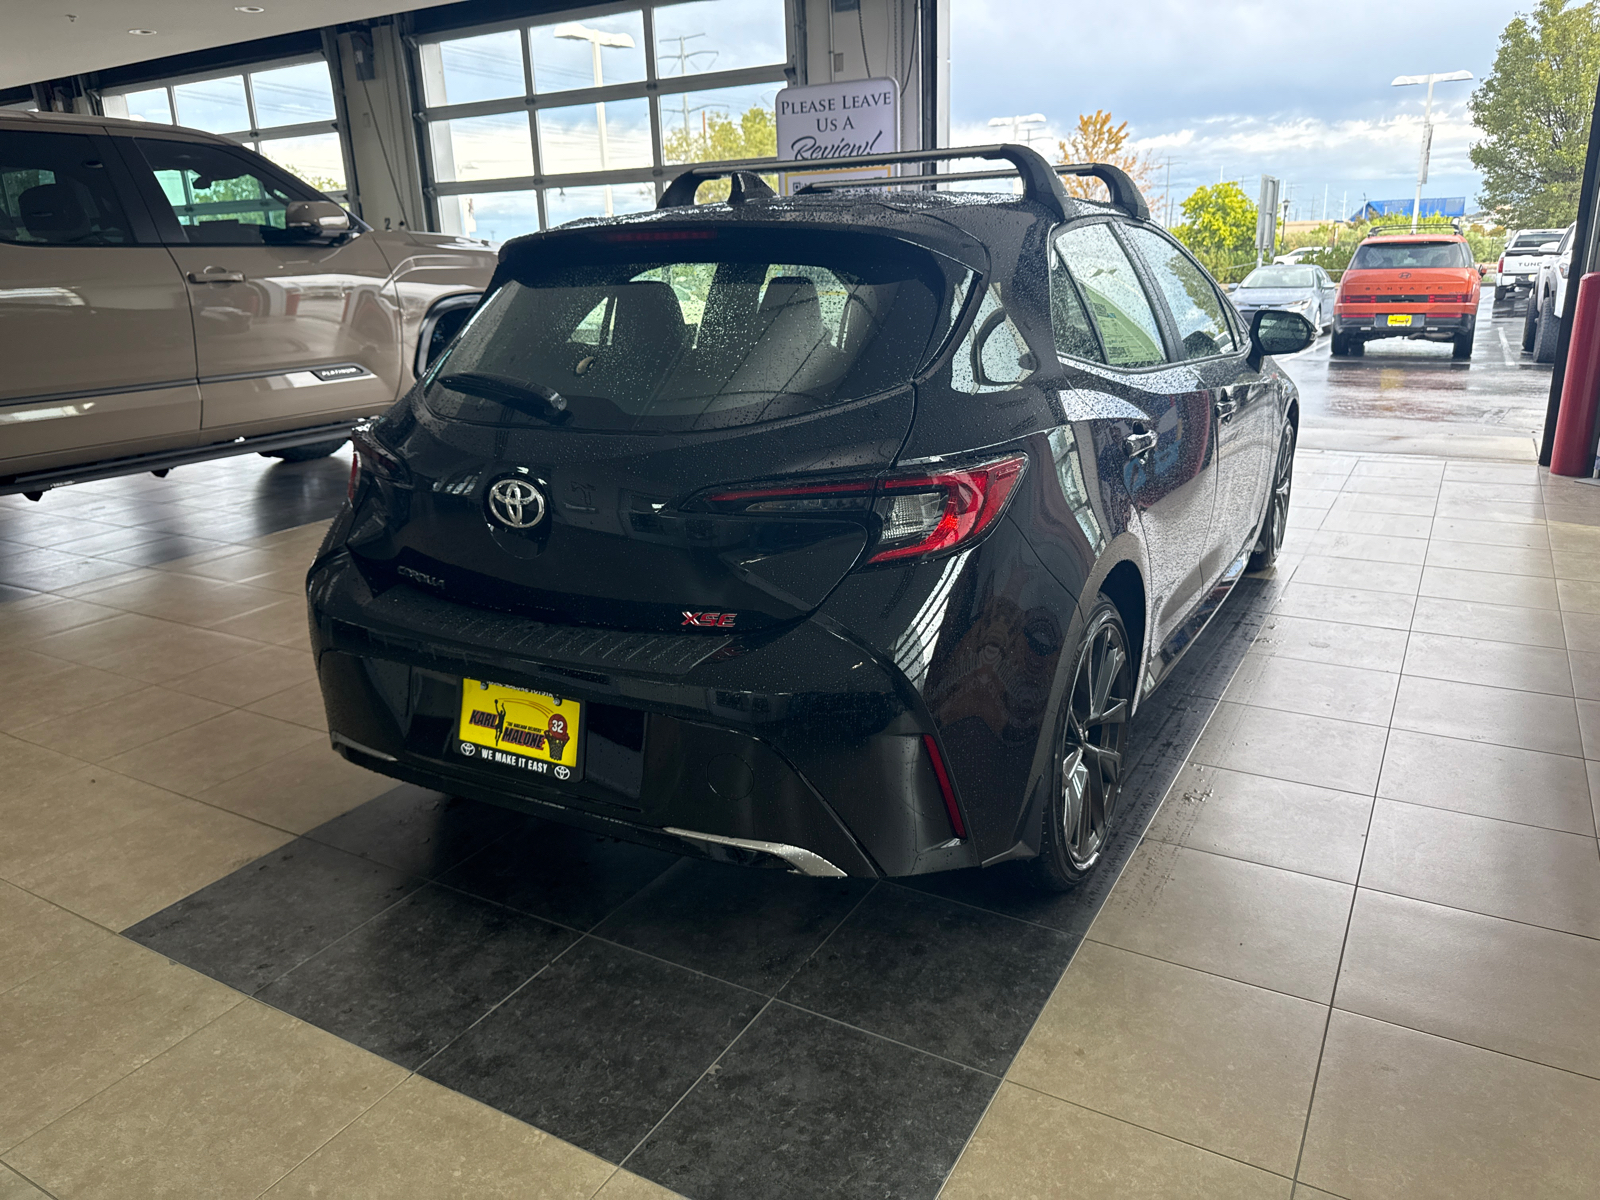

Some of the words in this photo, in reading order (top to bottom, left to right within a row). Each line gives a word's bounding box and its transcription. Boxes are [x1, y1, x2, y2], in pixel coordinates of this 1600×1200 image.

[781, 98, 836, 115] PLEASE
[842, 92, 892, 110] LEAVE
[816, 118, 838, 132] US
[843, 115, 854, 130] A
[791, 130, 883, 160] Review!
[681, 611, 737, 627] XSE
[469, 709, 498, 730] KARL
[551, 720, 564, 733] 32
[501, 726, 546, 750] MALONE
[481, 748, 493, 759] WE
[495, 752, 516, 765] MAKE
[518, 758, 526, 768] IT
[527, 760, 548, 774] EASY
